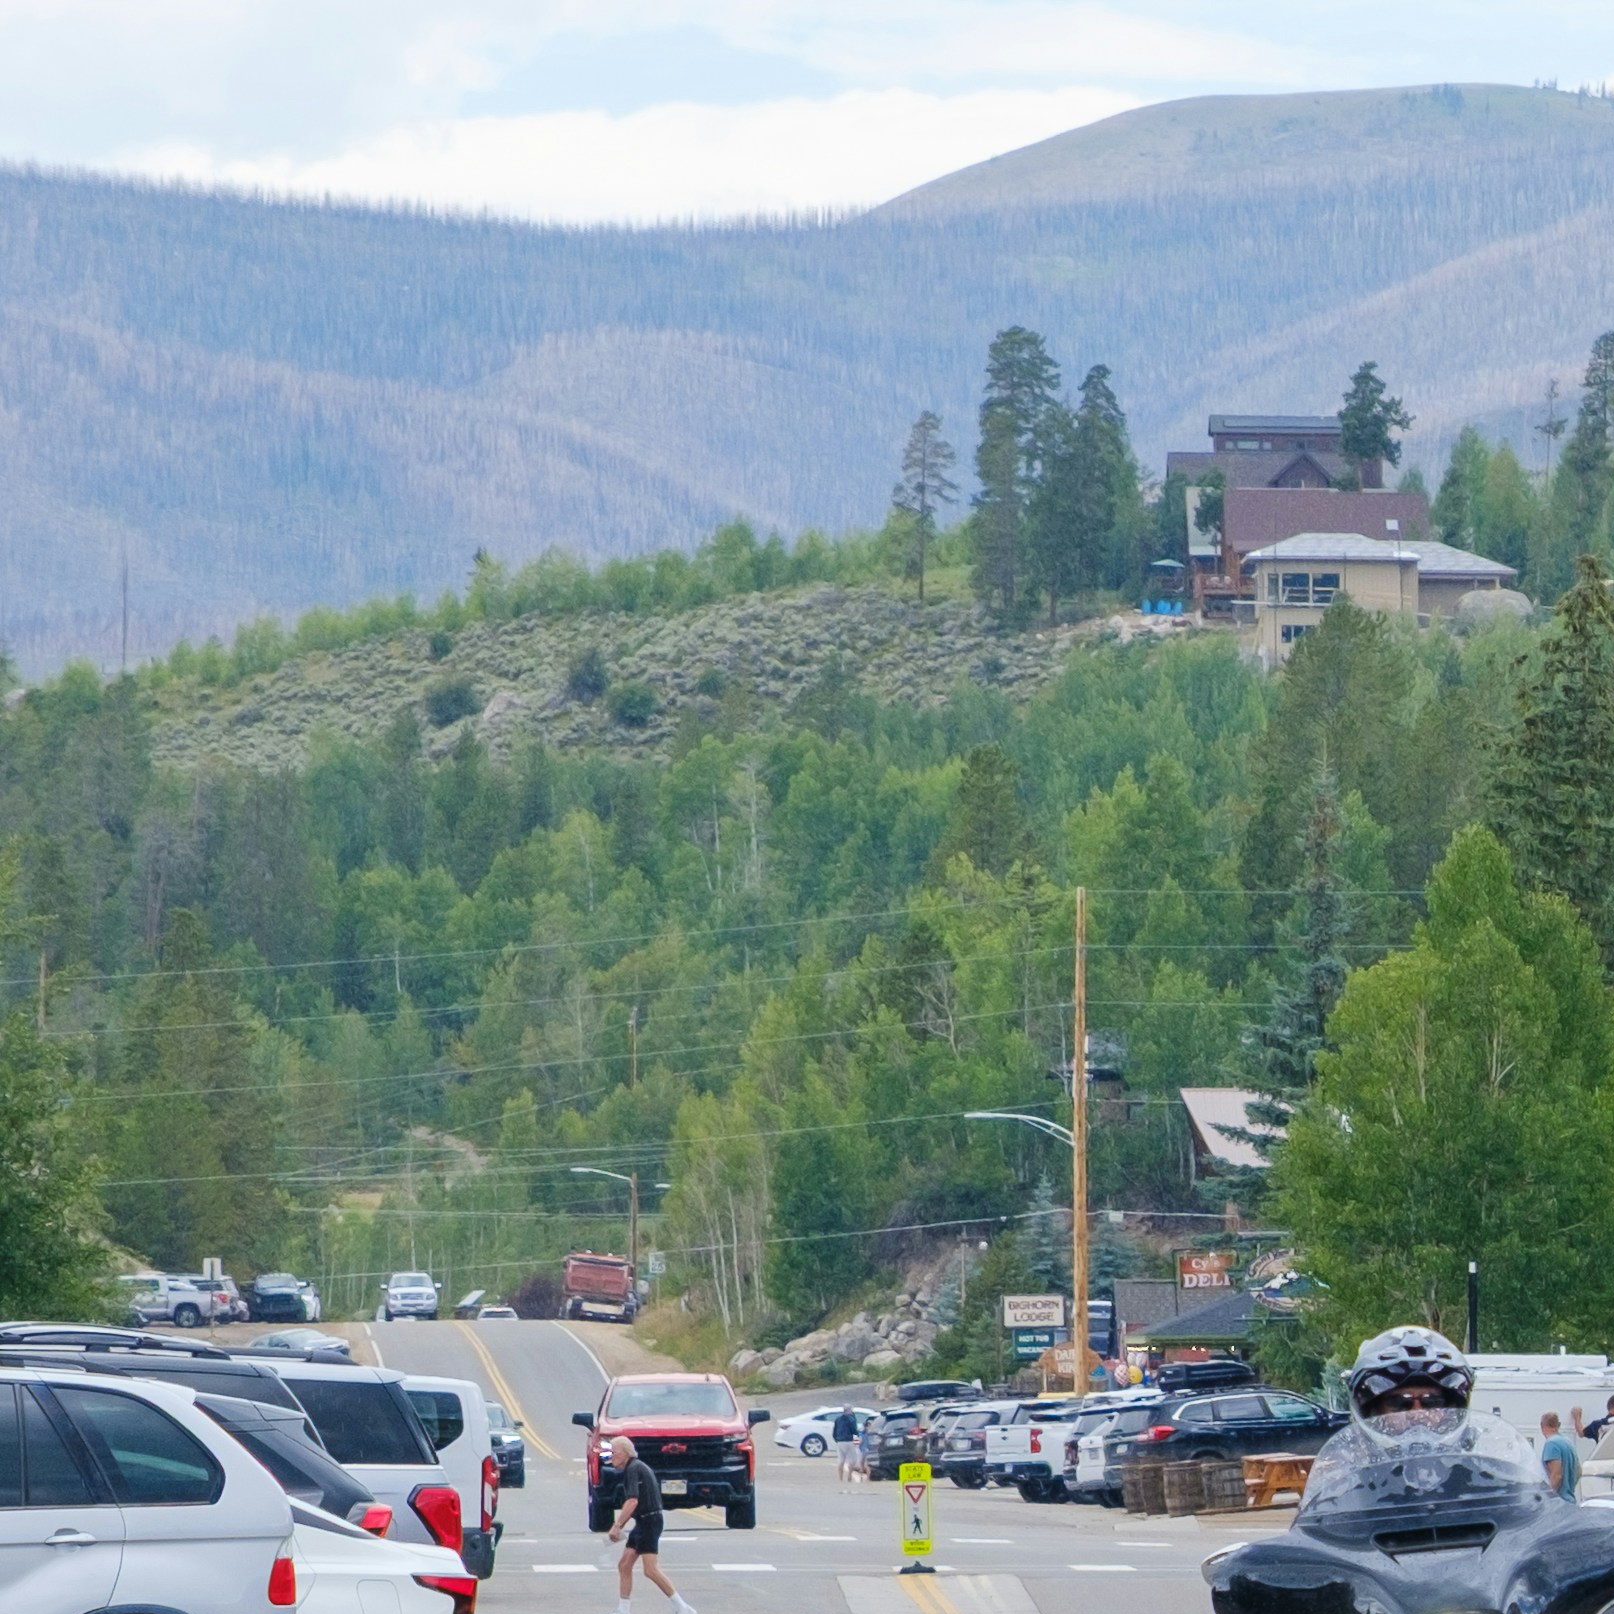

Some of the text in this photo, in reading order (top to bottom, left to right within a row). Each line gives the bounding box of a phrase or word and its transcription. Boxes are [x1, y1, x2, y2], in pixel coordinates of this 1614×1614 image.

[1182, 1272, 1231, 1288] DELI
[1008, 1300, 1060, 1311] BIGHORN
[1014, 1311, 1055, 1322] LODGE
